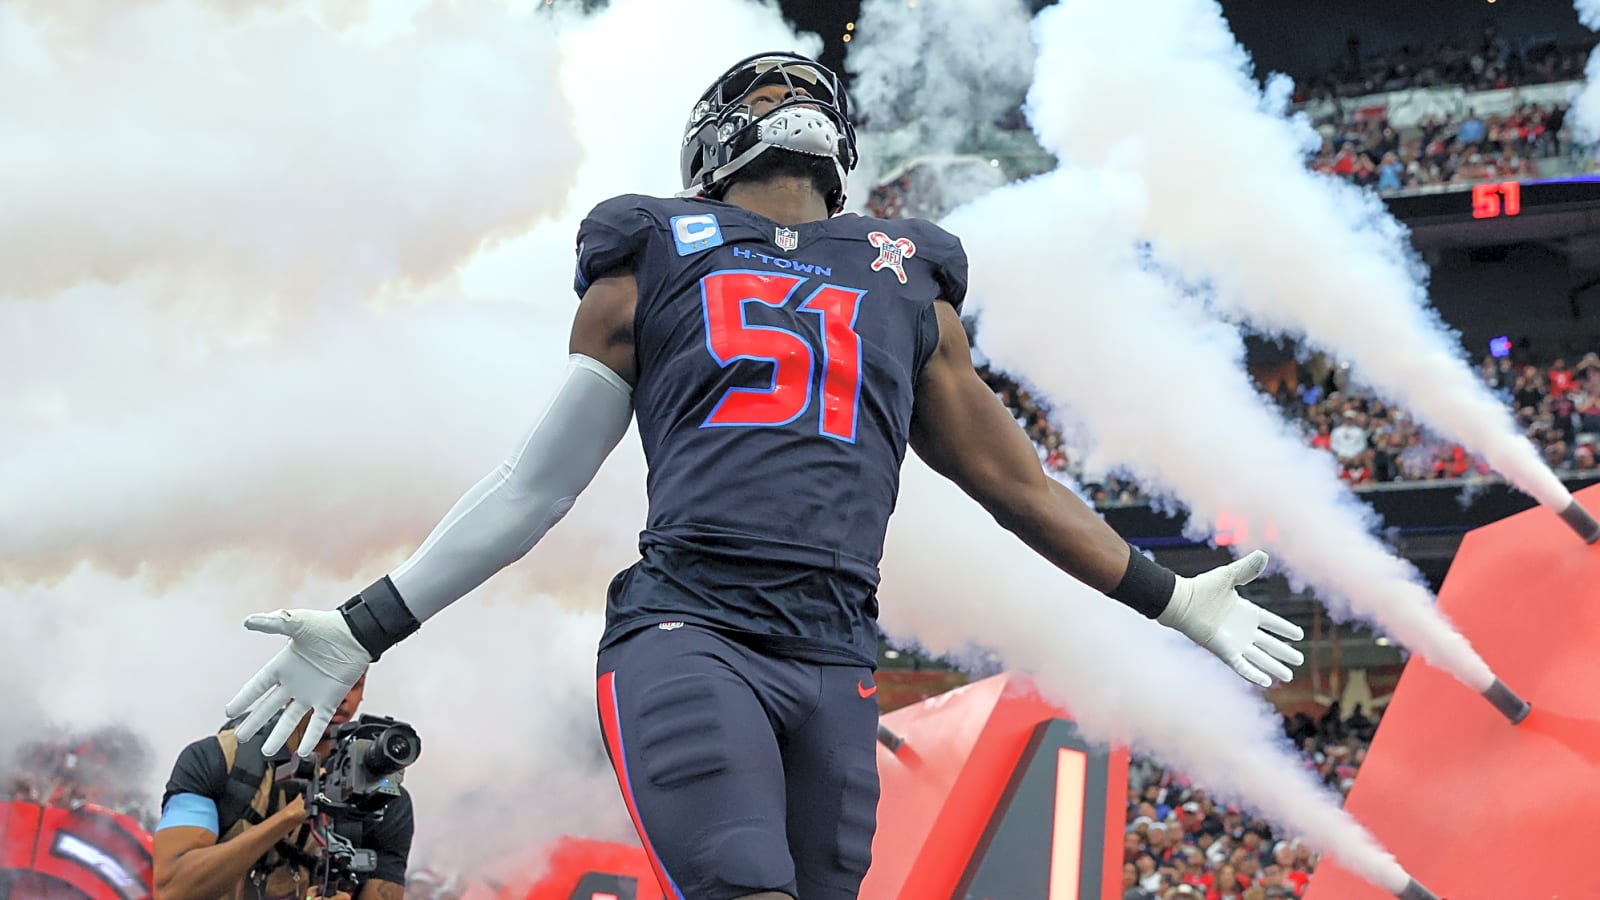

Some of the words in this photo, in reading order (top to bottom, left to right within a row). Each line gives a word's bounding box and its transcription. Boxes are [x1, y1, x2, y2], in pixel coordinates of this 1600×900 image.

[1472, 182, 1520, 219] 51
[675, 215, 717, 244] C
[733, 247, 832, 276] H-TOWN
[699, 269, 868, 444] 51
